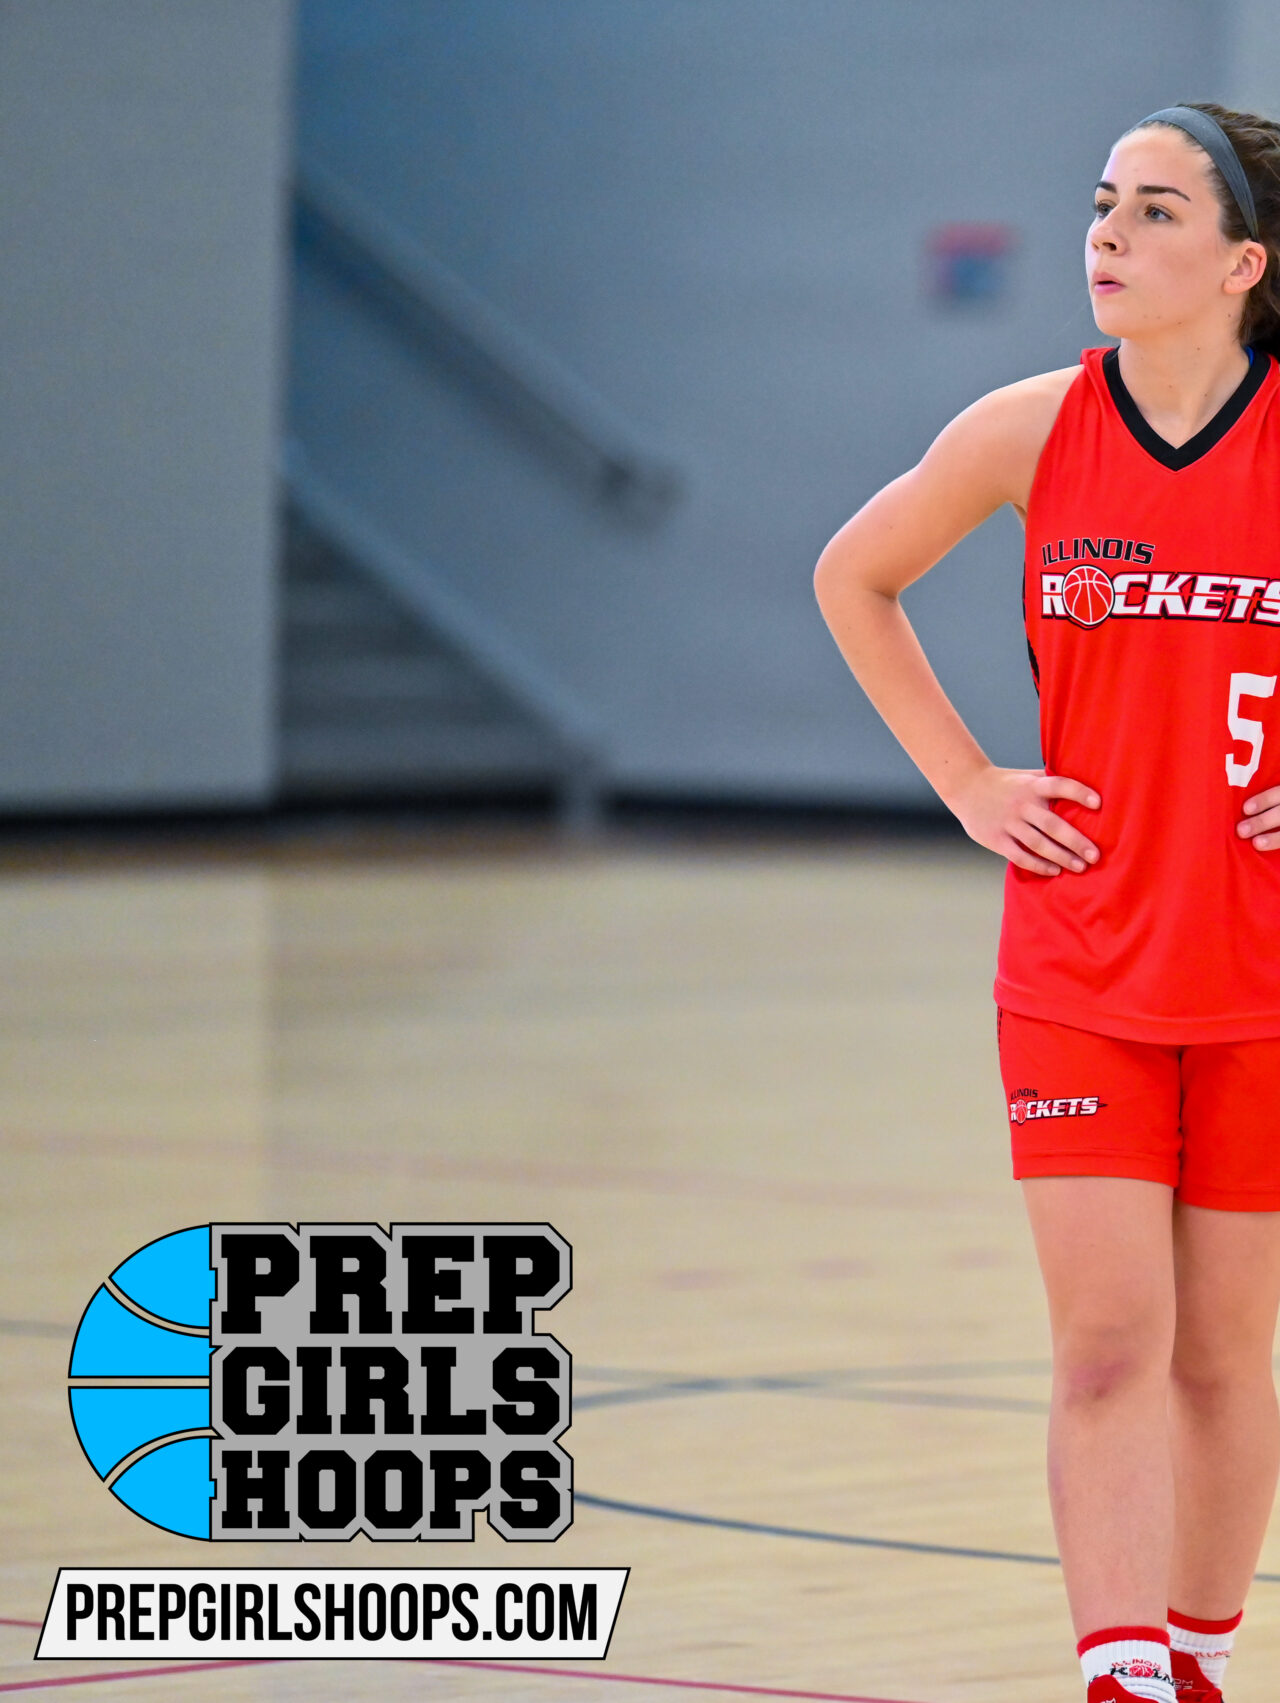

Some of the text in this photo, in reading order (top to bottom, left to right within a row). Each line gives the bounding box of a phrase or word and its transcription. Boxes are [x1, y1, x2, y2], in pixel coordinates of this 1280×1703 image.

[1042, 537, 1155, 566] ILLINOIS
[1225, 672, 1278, 788] 5
[1009, 1096, 1100, 1125] ROCKETS
